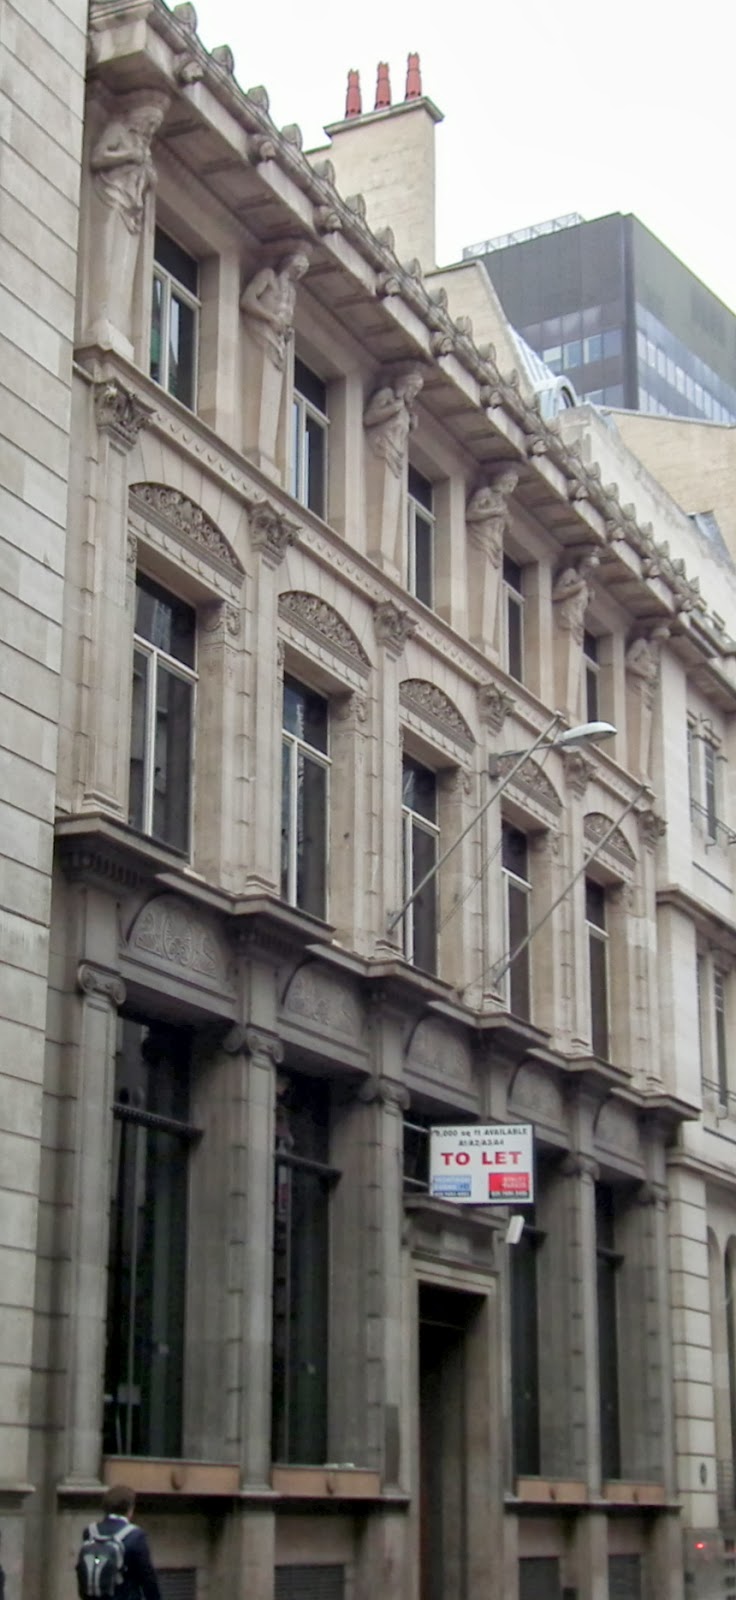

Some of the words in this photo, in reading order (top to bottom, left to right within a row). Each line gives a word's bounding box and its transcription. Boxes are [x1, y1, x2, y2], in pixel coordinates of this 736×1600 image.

[484, 1127, 528, 1136] AVAILABLE
[440, 1151, 471, 1166] TO
[481, 1151, 523, 1166] LET
